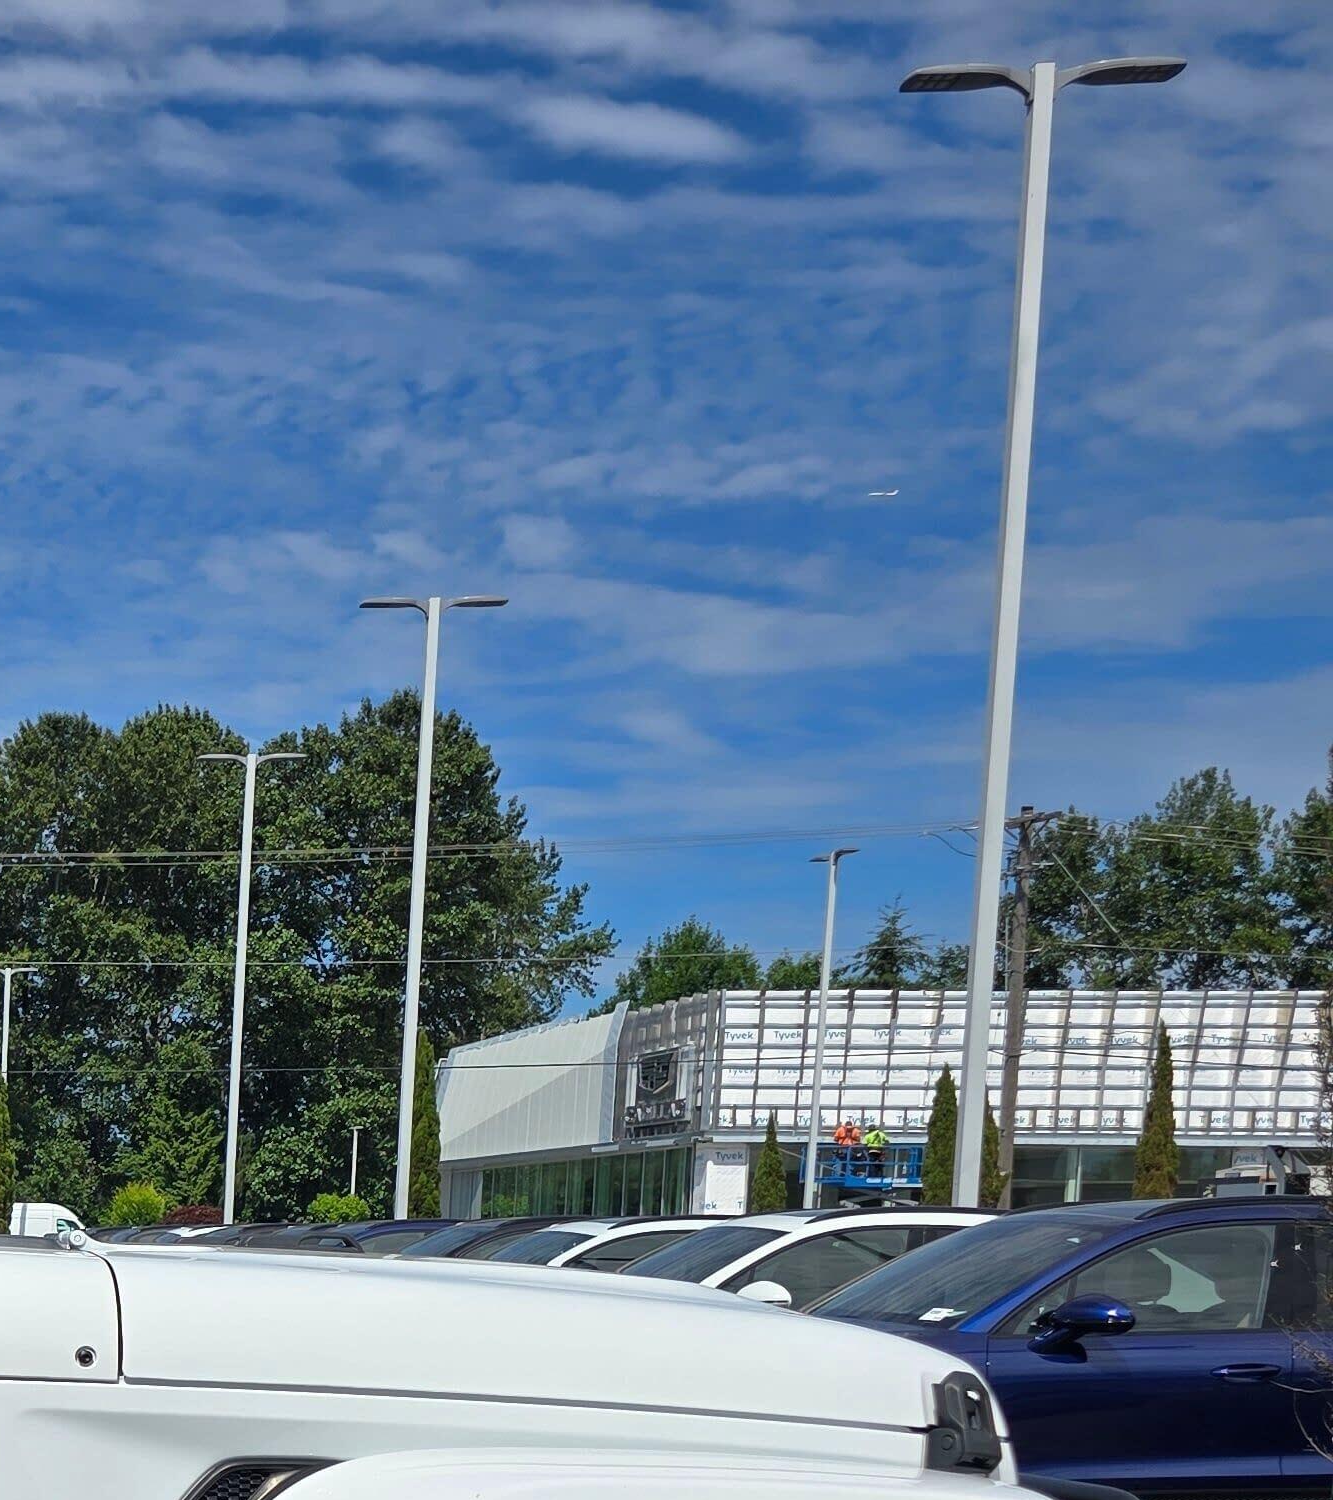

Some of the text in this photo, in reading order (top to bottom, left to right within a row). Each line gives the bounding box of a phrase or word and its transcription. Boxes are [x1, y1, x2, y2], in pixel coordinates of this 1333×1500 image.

[725, 1031, 754, 1041] Tyvek
[773, 1030, 802, 1040] Tyvek
[715, 1151, 743, 1161] Tyvek
